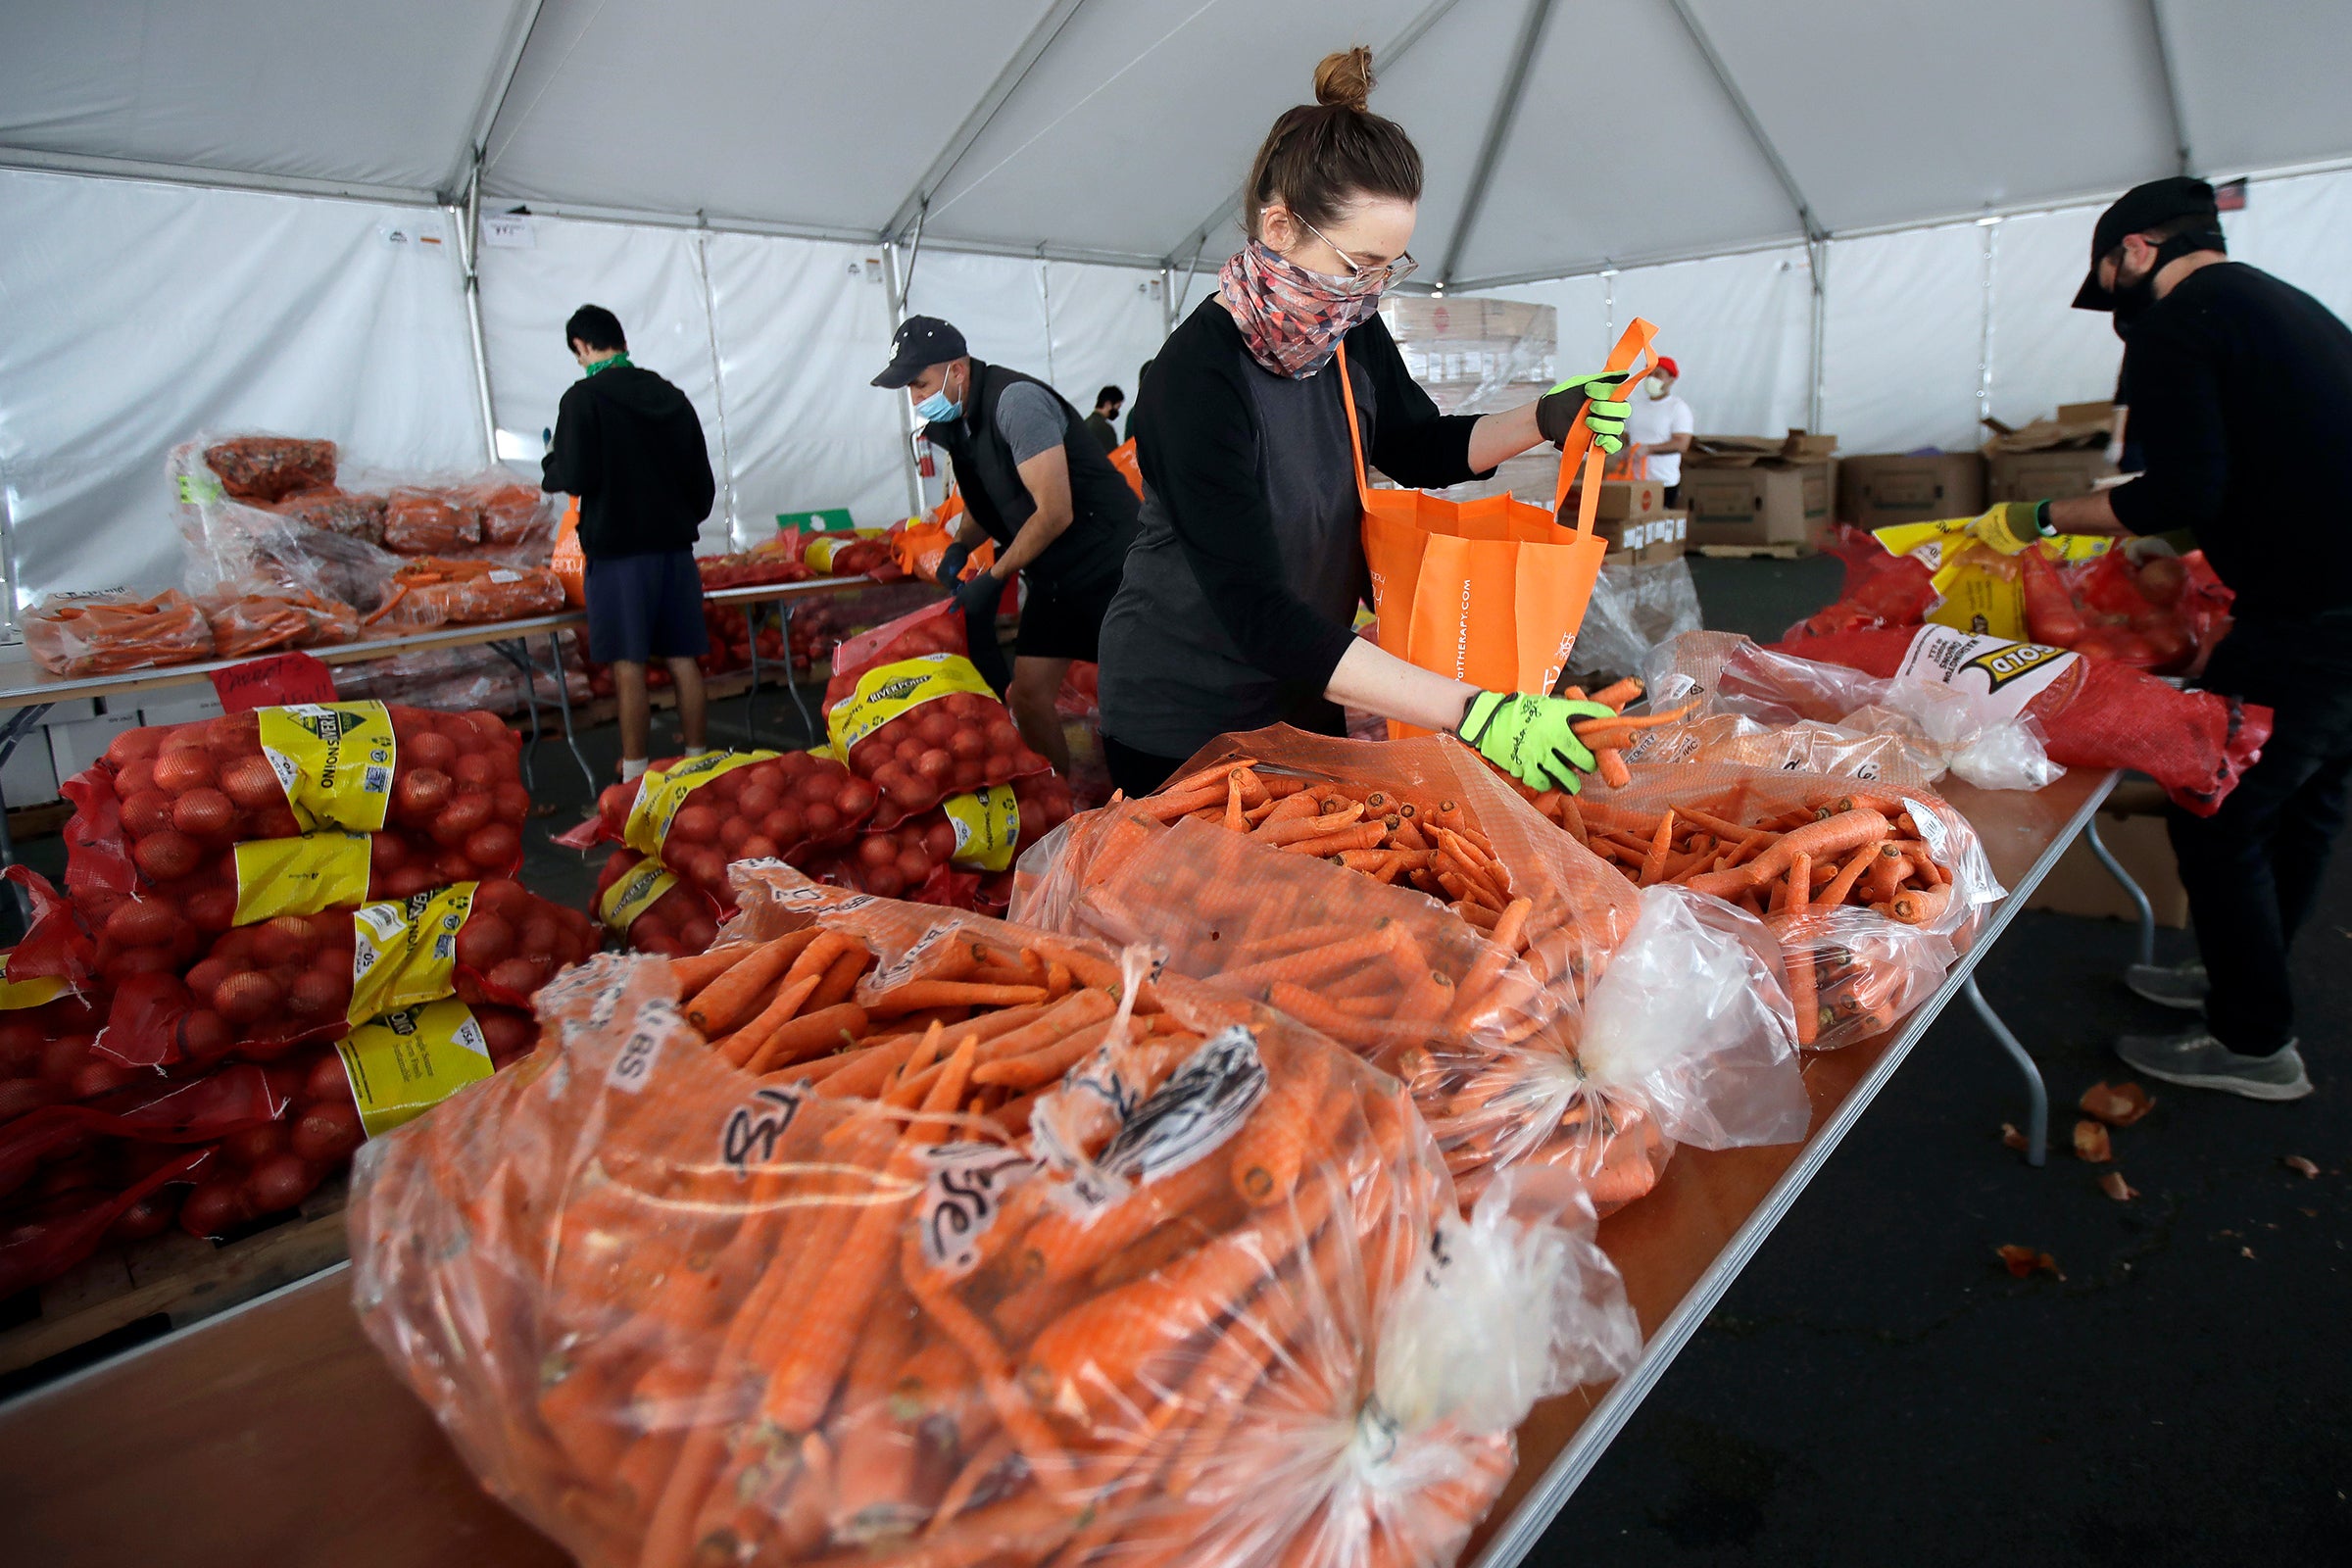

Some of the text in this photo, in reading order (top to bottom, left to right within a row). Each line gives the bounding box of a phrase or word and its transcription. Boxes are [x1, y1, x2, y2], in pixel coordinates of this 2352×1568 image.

[1991, 644, 2057, 673] GOLD
[869, 675, 930, 703] RIVER POINT
[841, 704, 863, 734] ONIONS
[321, 739, 340, 788] ONIONS
[462, 1027, 475, 1046] USA
